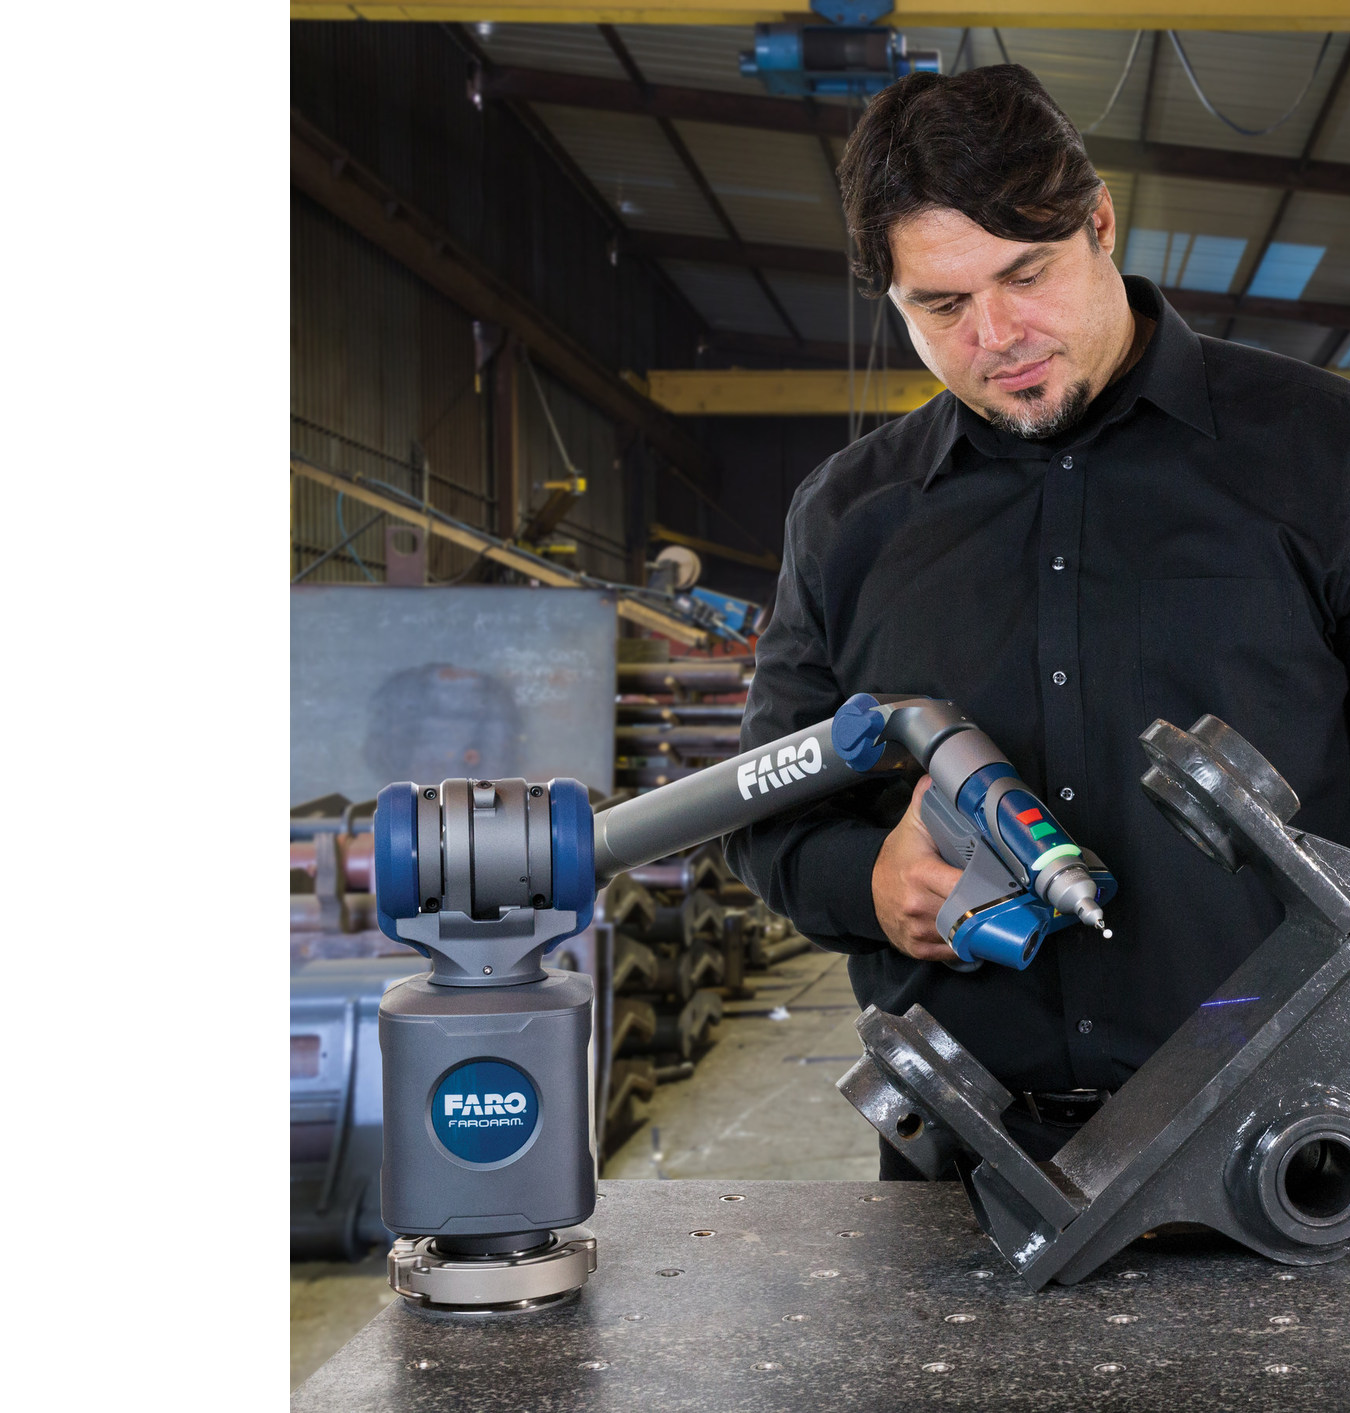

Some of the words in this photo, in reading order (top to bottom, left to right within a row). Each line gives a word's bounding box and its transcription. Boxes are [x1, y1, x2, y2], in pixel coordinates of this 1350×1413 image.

[737, 736, 822, 801] FARO
[444, 1092, 527, 1116] FARO
[448, 1118, 523, 1128] FAROARM
